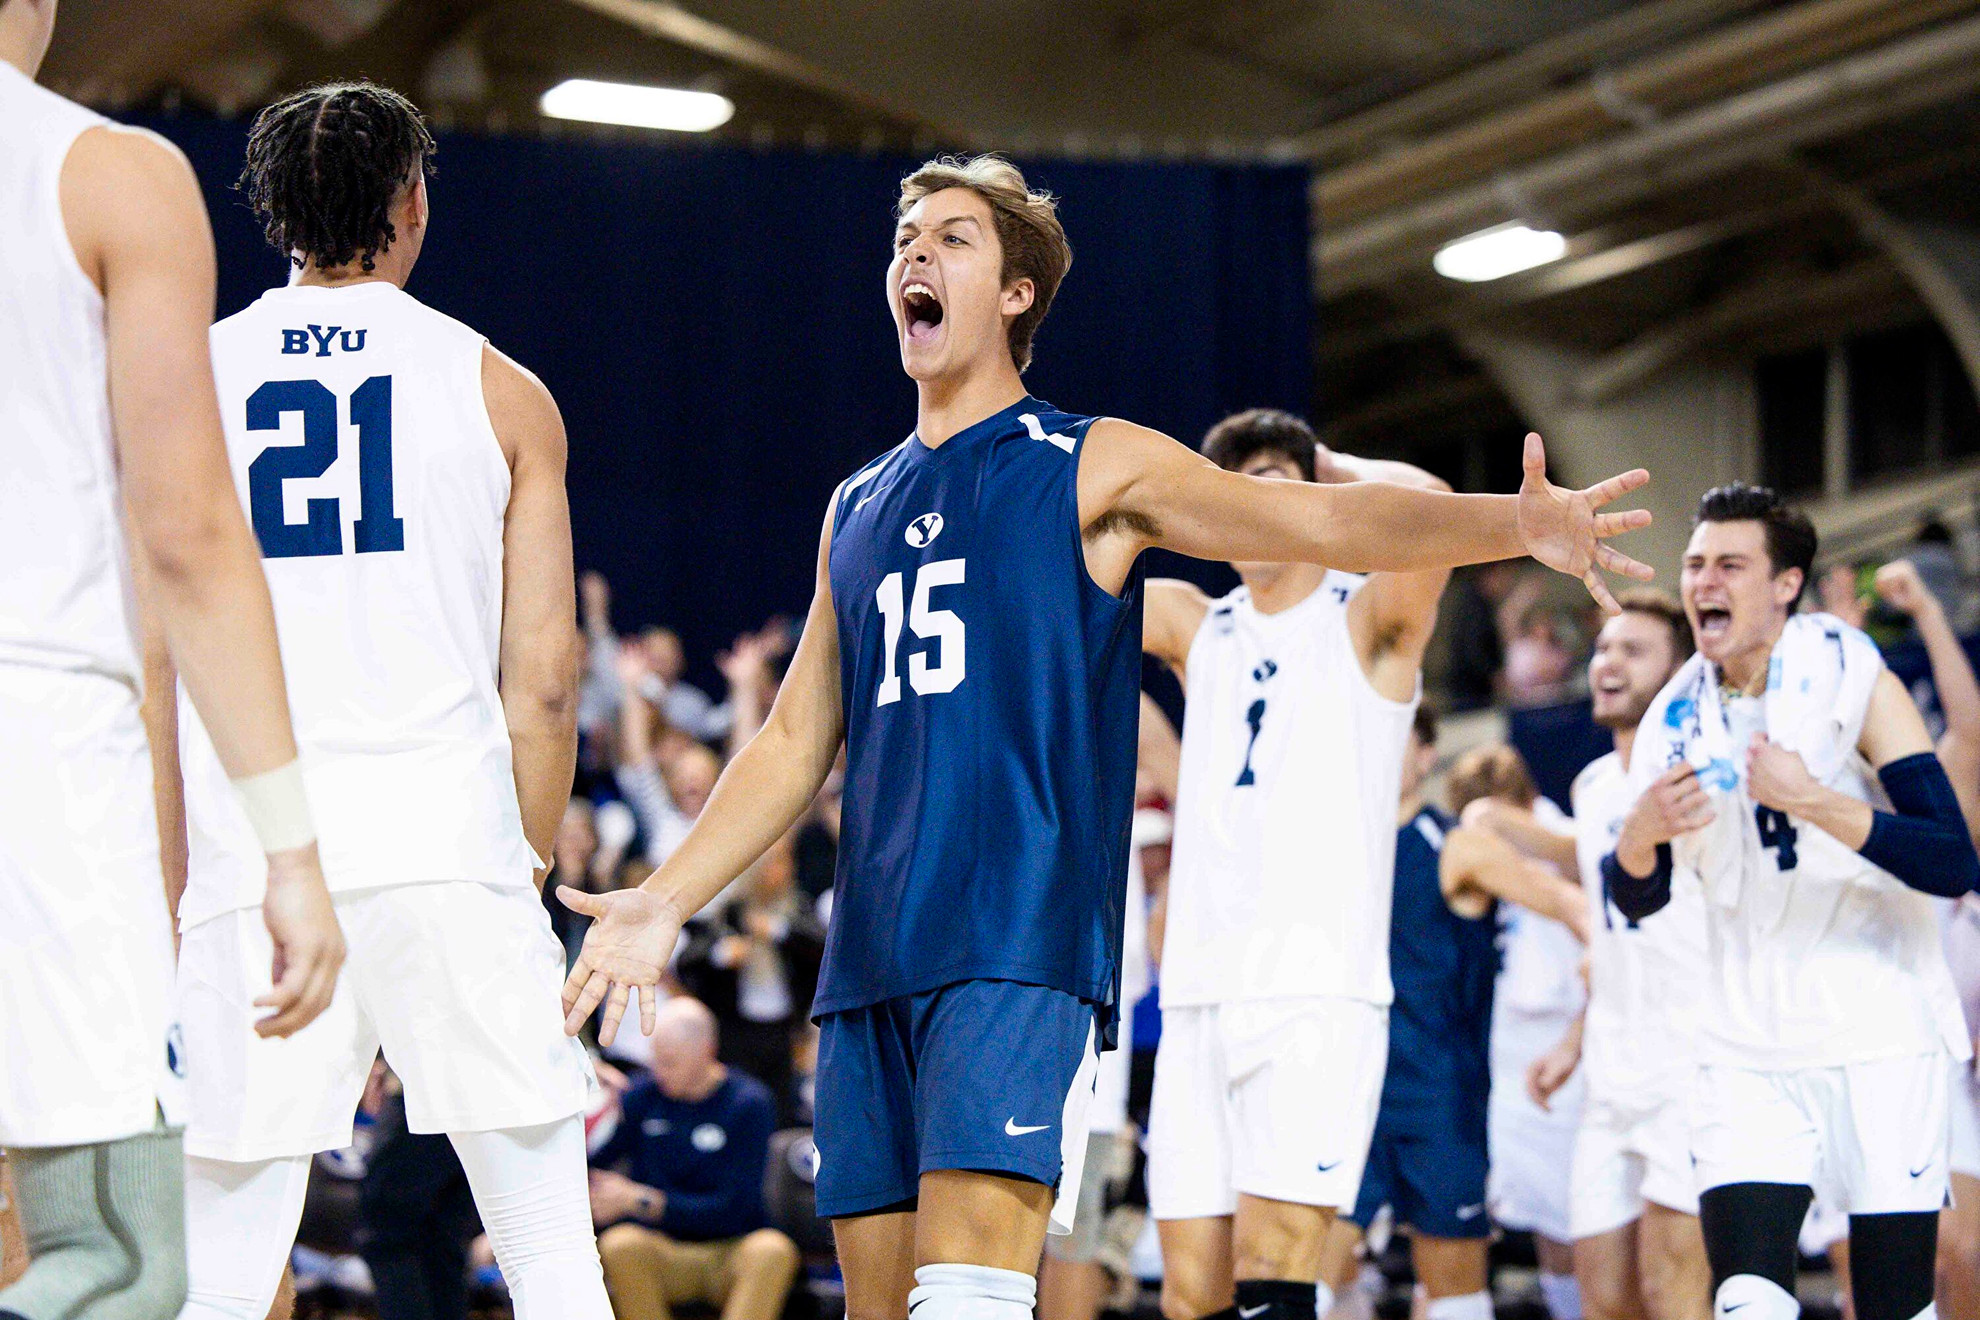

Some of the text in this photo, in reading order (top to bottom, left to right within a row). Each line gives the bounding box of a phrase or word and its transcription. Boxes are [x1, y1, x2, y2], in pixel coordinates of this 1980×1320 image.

[281, 324, 367, 357] BYU
[246, 374, 404, 558] 21
[911, 515, 939, 545] Y
[875, 557, 966, 707] 15
[1755, 803, 1798, 871] 4
